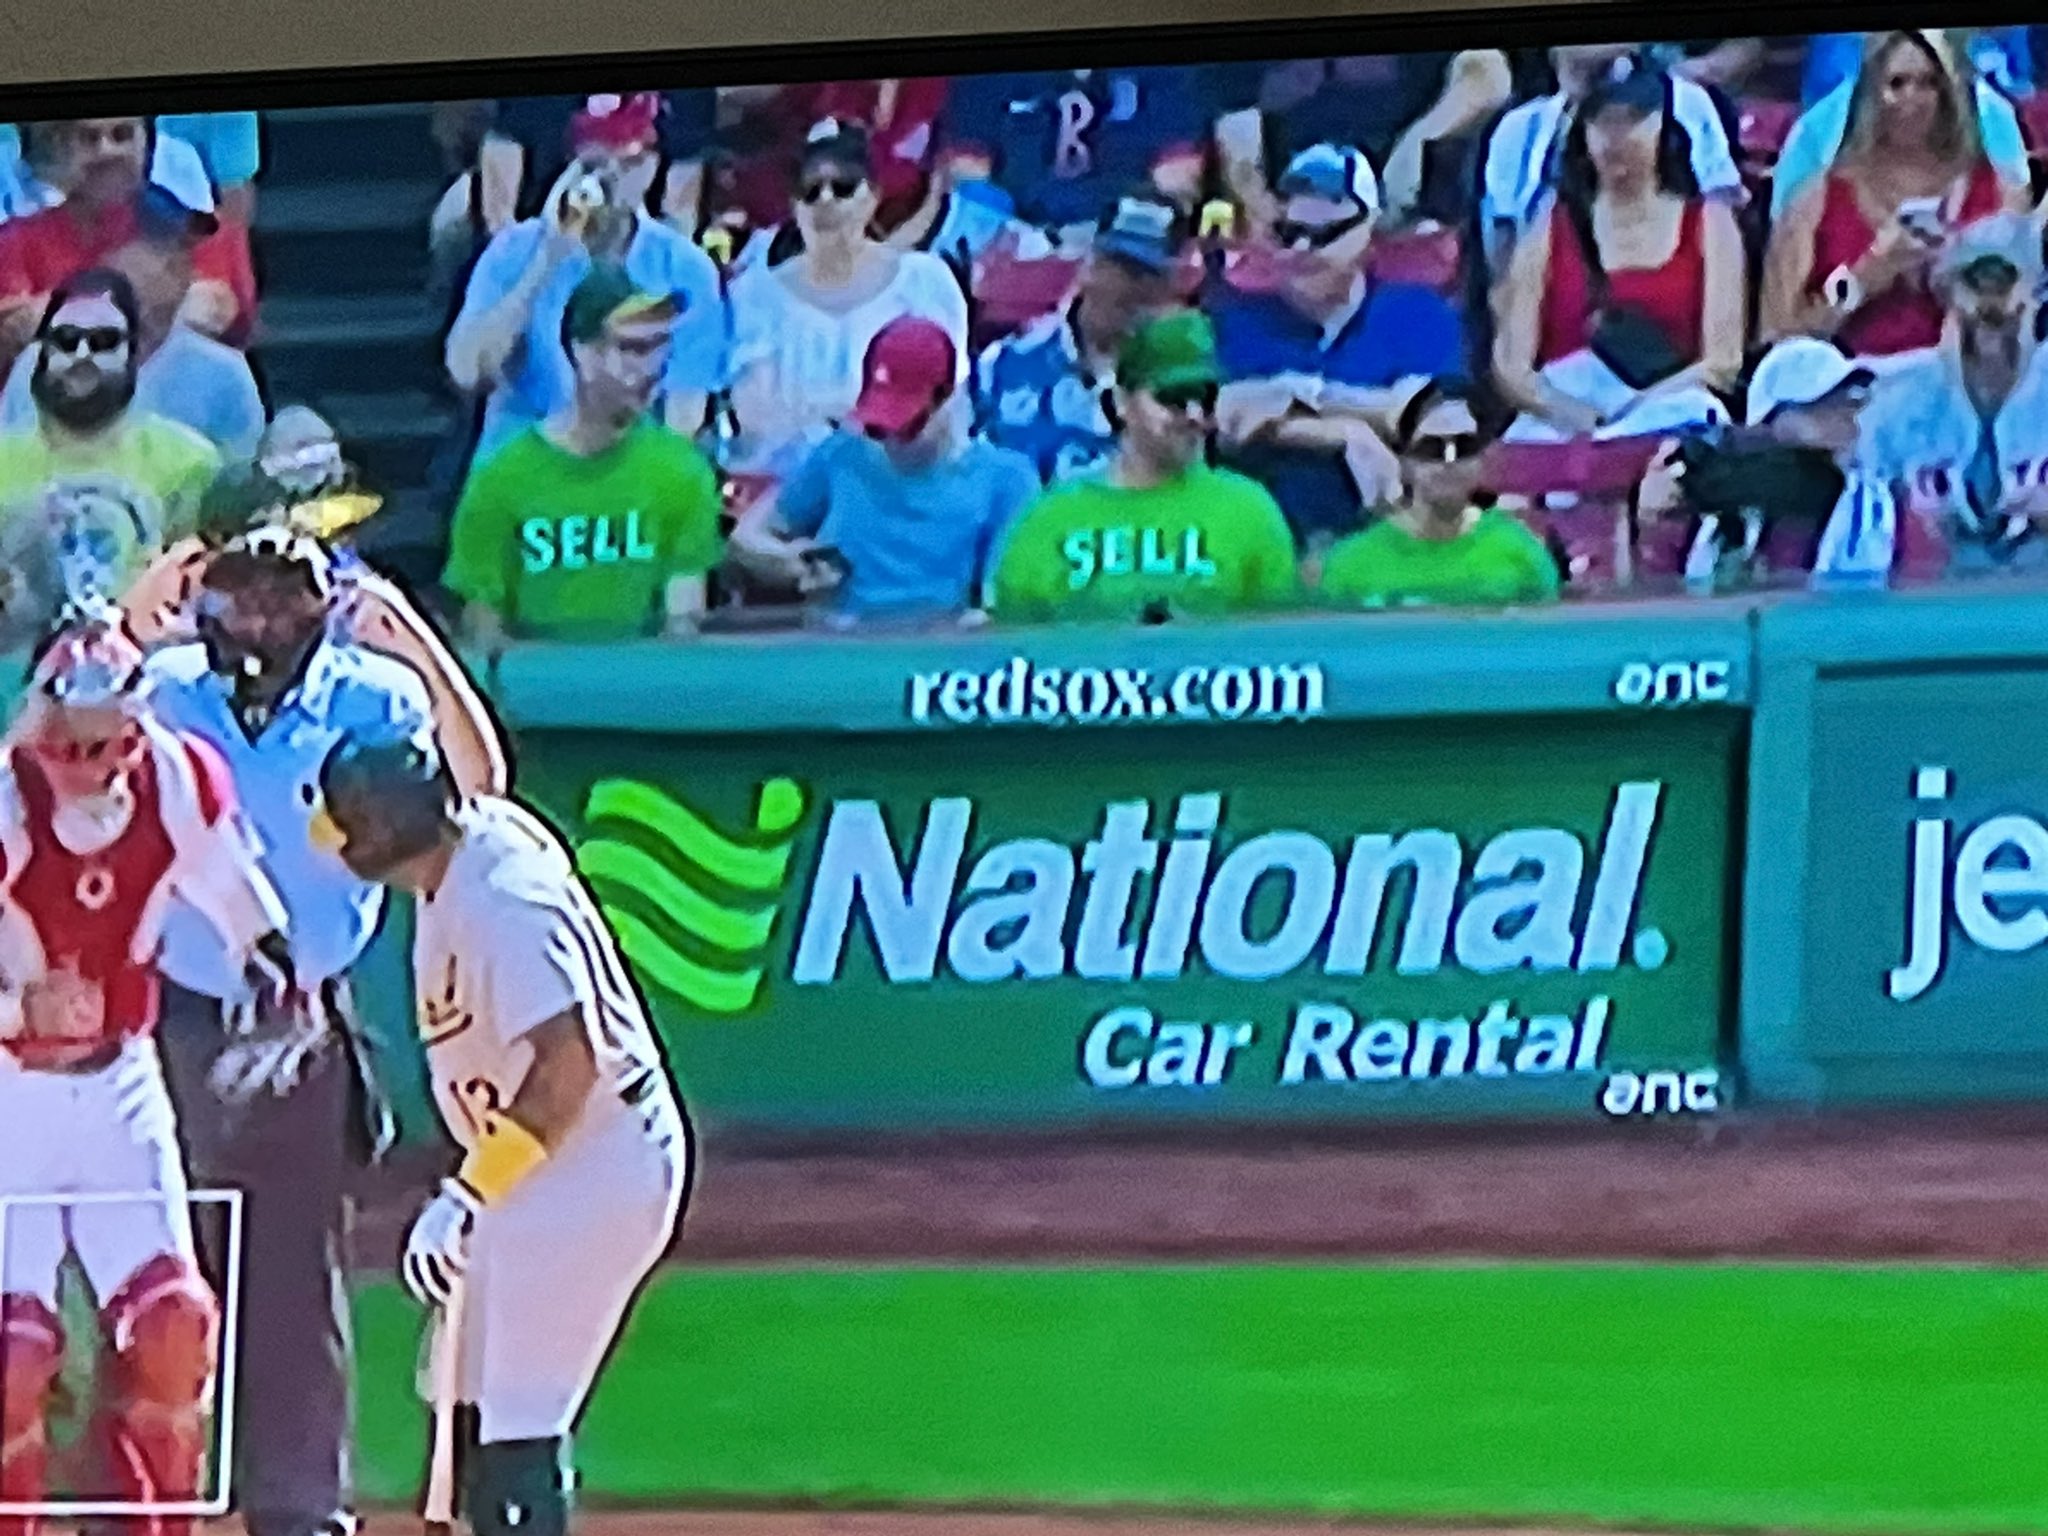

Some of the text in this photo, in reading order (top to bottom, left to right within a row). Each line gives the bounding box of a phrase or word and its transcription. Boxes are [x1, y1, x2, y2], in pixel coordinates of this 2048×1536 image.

[522, 510, 654, 572] SELL
[1063, 526, 1216, 589] SELL
[910, 656, 1325, 722] redsox.com
[1083, 995, 1608, 1086] Car Rental
